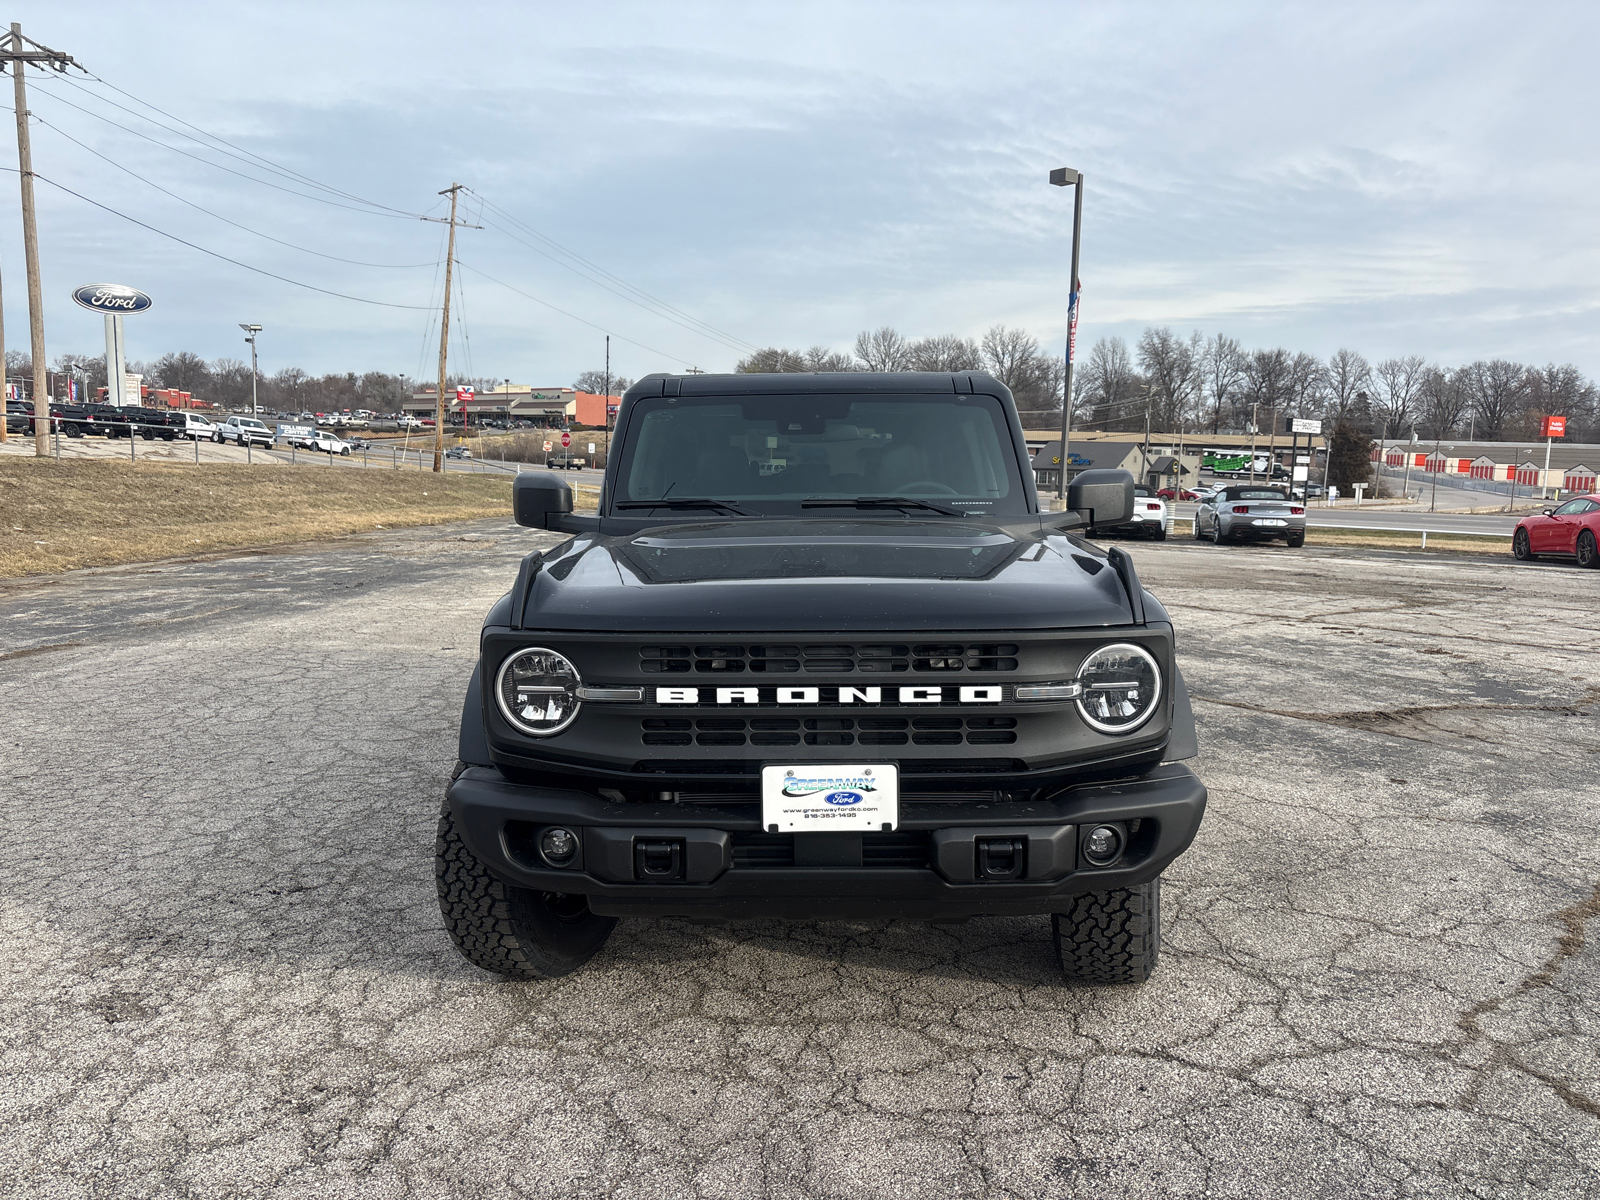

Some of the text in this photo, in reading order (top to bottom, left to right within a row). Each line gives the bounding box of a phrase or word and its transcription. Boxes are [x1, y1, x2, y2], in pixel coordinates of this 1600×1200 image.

[91, 289, 137, 309] Ford
[280, 424, 313, 432] COLLISION
[656, 686, 1002, 703] BRONCO
[783, 776, 876, 792] GREENWAY
[832, 793, 856, 804] Ford
